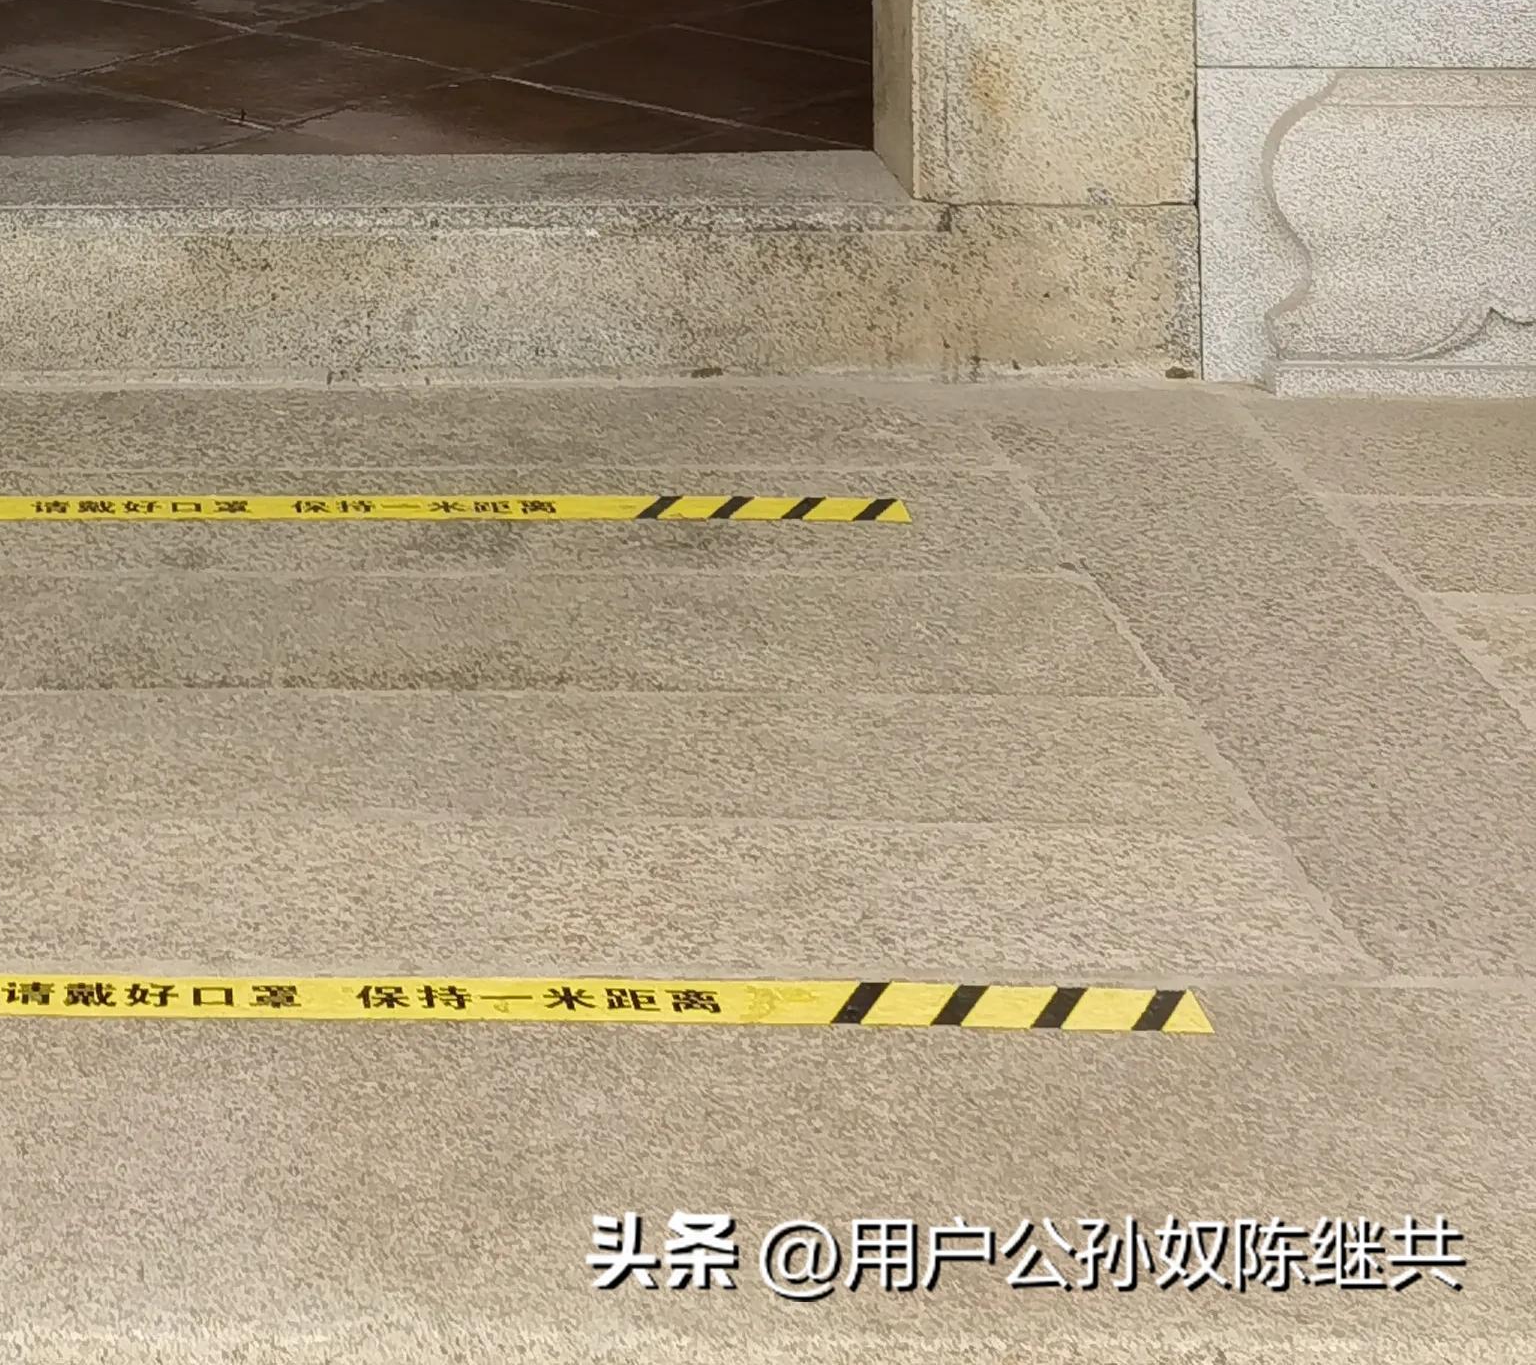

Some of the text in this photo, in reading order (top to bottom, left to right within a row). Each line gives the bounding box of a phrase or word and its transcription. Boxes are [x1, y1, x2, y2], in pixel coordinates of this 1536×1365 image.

[31, 499, 557, 515] 请戴好口罩 保持一米距离
[0, 981, 723, 1014] 请戴好口罩 保持一米距离
